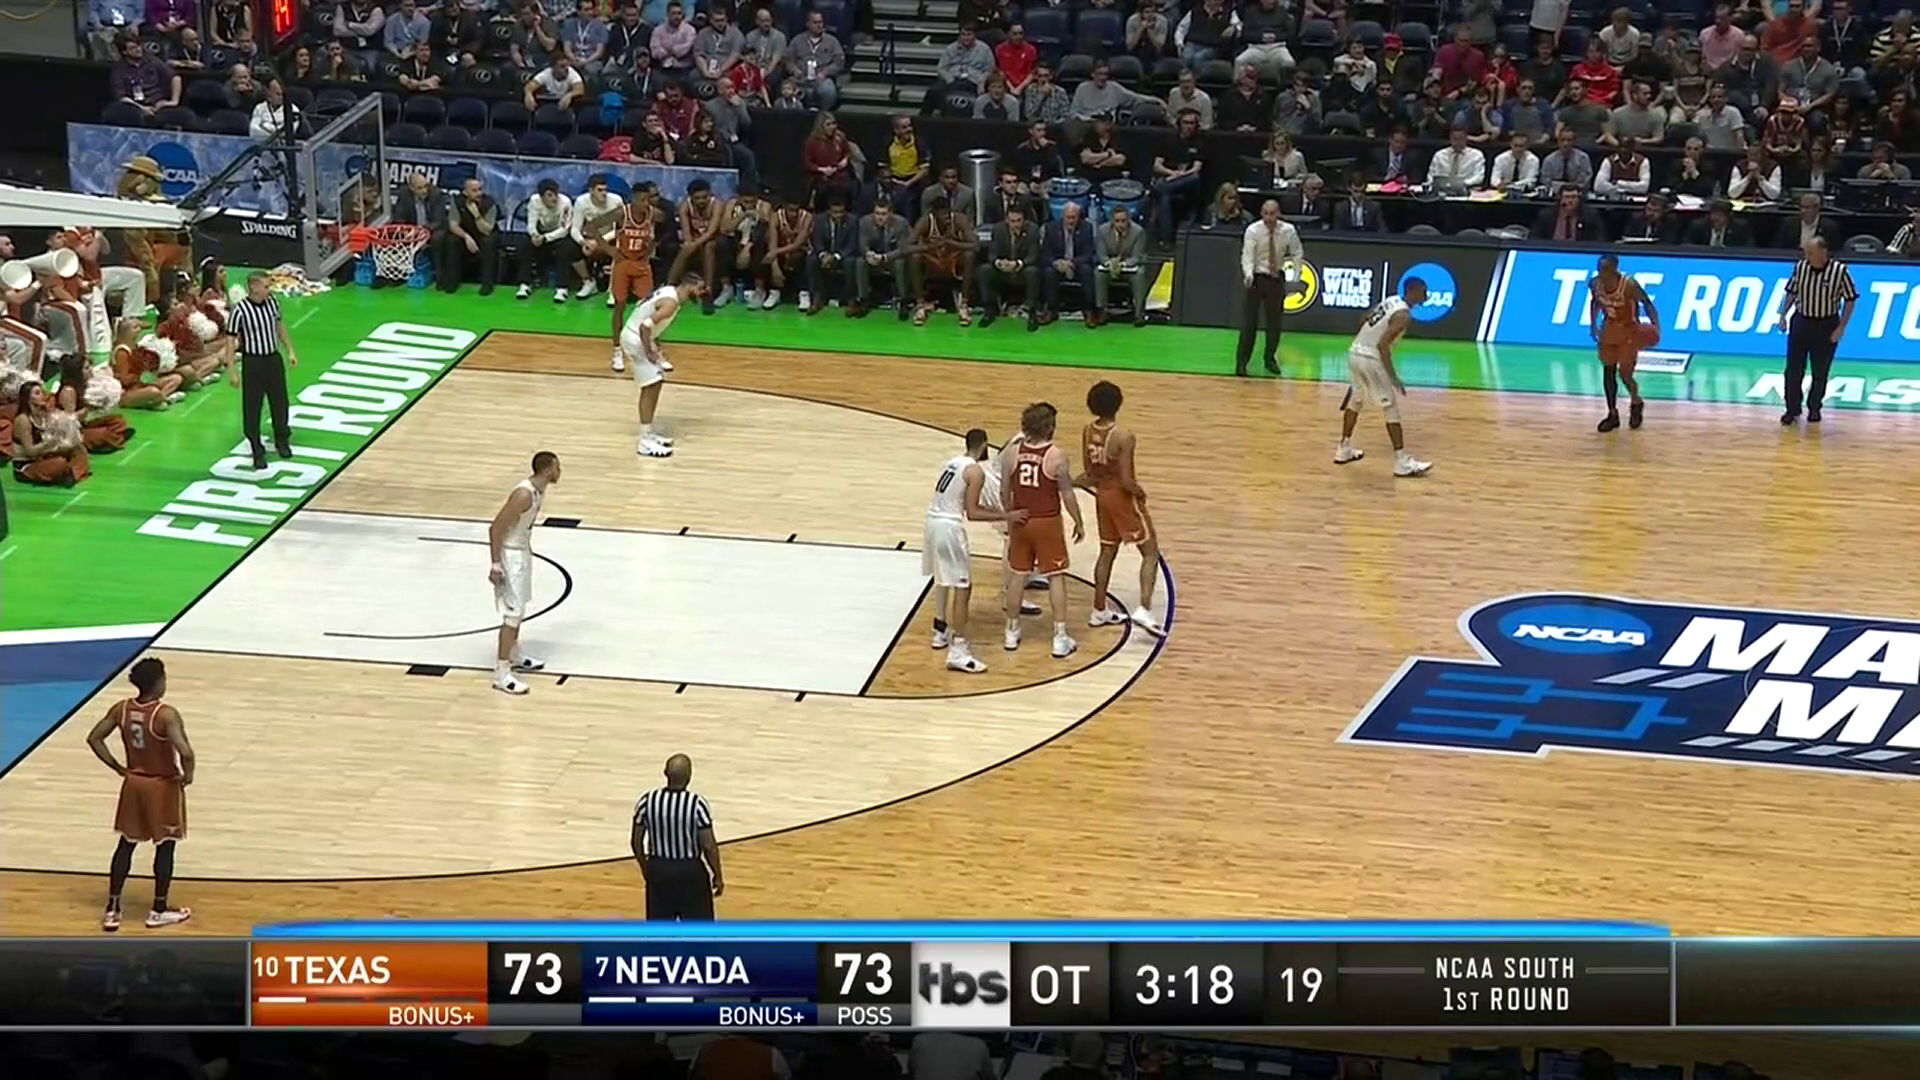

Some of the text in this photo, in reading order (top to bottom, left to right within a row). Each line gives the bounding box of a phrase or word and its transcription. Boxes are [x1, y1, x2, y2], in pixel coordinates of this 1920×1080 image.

[163, 168, 200, 183] CAA
[241, 220, 298, 239] SPALDING
[628, 238, 644, 251] 12
[1322, 267, 1373, 279] BUFFALO
[1323, 277, 1373, 294] WILD
[1321, 292, 1371, 308] WINGS
[1551, 268, 1664, 325] TE
[285, 321, 478, 437] ROUND
[935, 469, 956, 493] 10
[1019, 463, 1040, 487] 21
[1512, 623, 1648, 648] NCAA
[130, 722, 145, 750] 3
